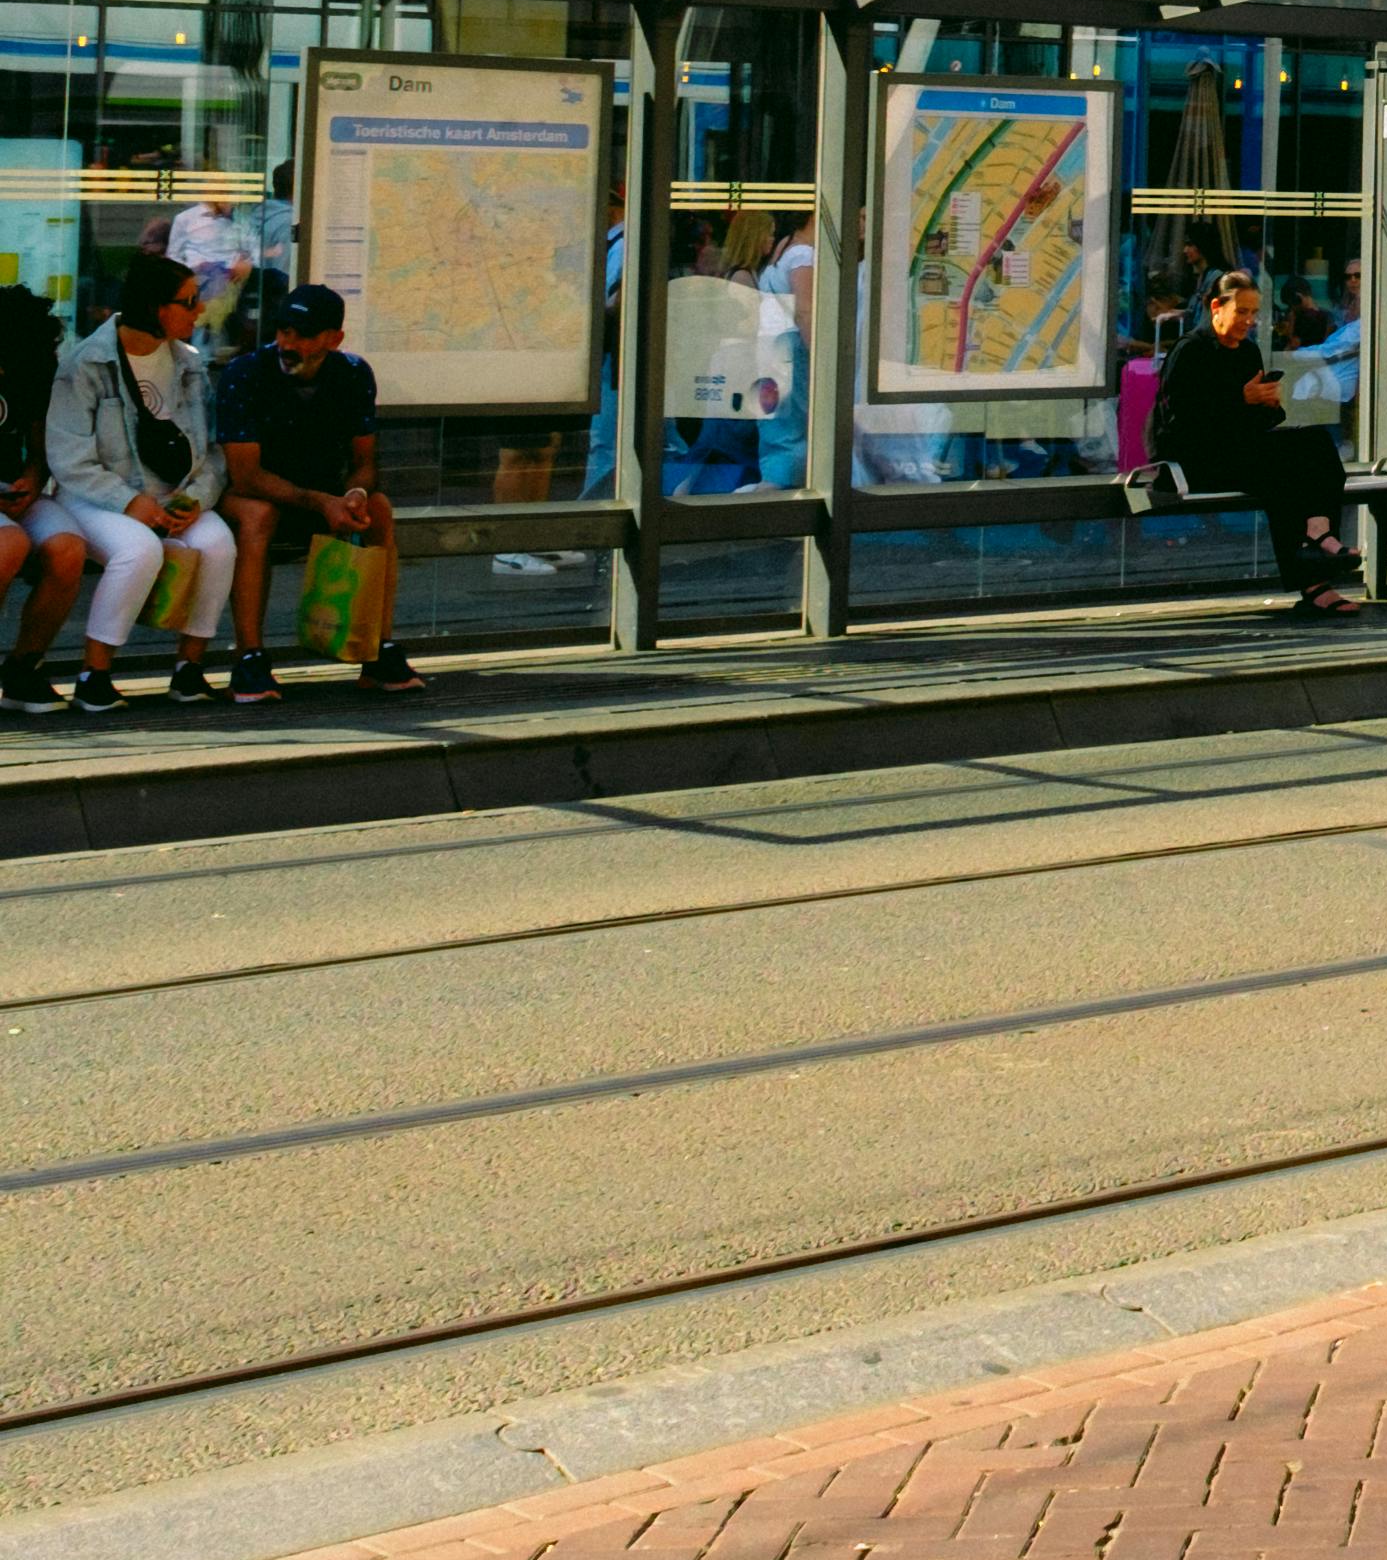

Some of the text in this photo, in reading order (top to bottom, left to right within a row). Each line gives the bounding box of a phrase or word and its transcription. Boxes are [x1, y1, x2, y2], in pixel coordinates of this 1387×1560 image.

[388, 75, 433, 93] Dam
[989, 96, 1016, 109] Dam
[353, 123, 569, 144] Toeristische kaart Amsterdam
